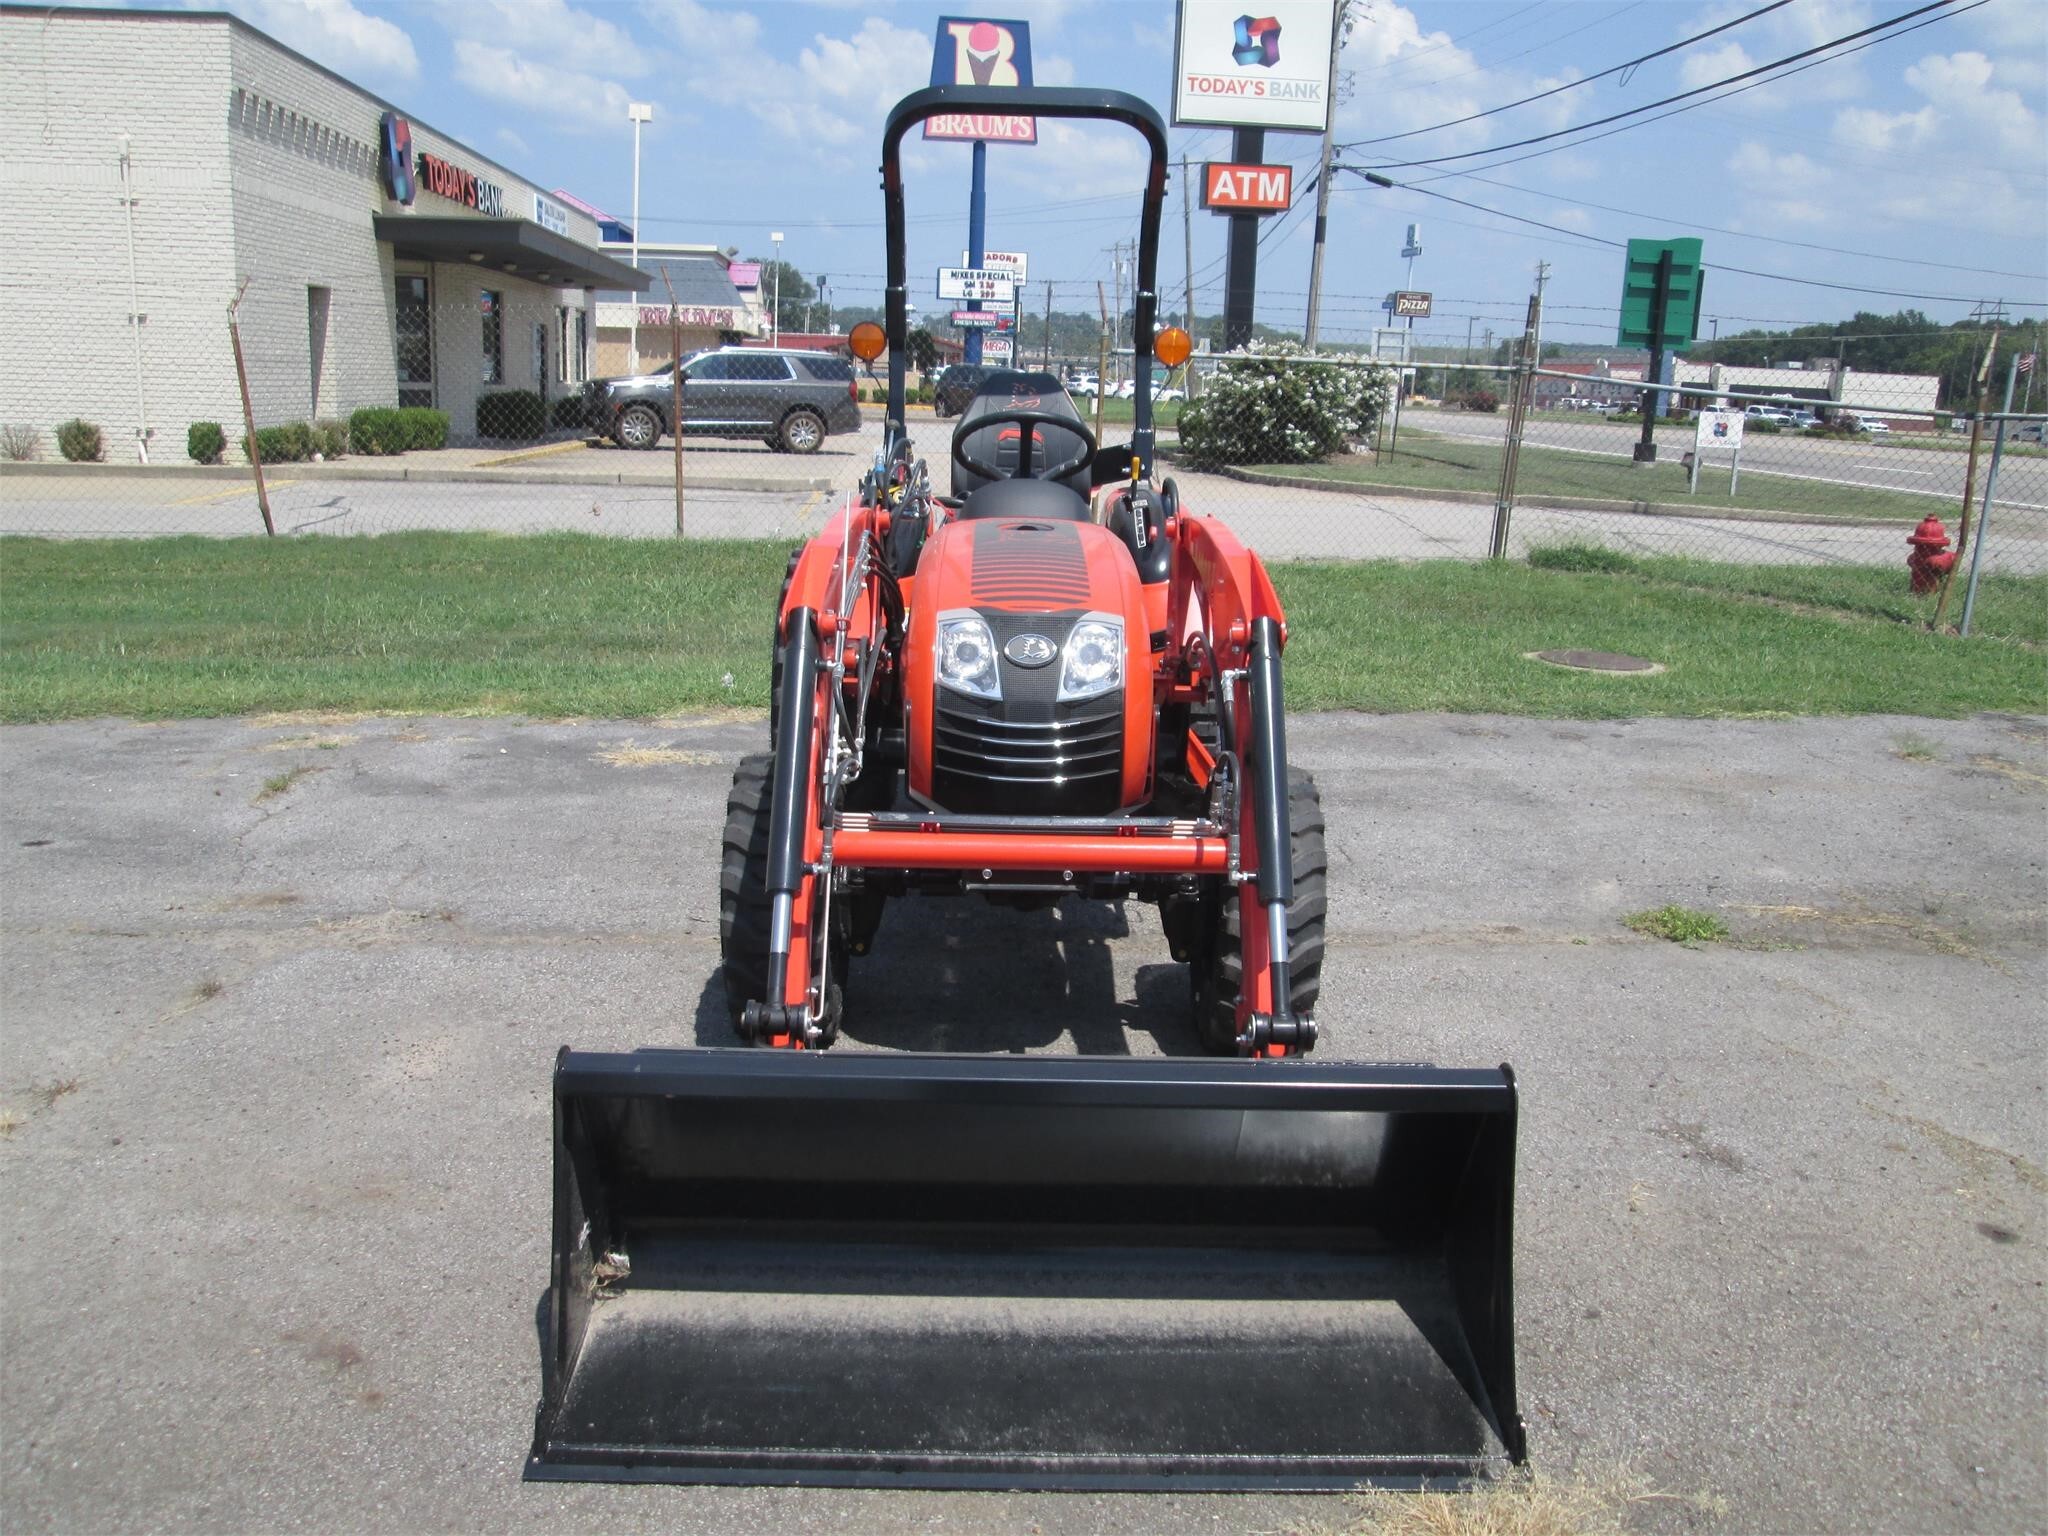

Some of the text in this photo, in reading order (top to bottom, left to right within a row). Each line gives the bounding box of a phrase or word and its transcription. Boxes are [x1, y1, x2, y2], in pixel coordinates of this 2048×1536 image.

[1187, 76, 1321, 100] TODAY'S BANK
[930, 114, 1031, 138] BRAUM'S
[423, 152, 476, 208] TODAY'S
[476, 178, 505, 218] BANK
[1212, 170, 1286, 202] ATM
[976, 272, 1011, 281] SPECIAL
[639, 306, 735, 327] BRUM'S
[983, 341, 1008, 352] MEGA
